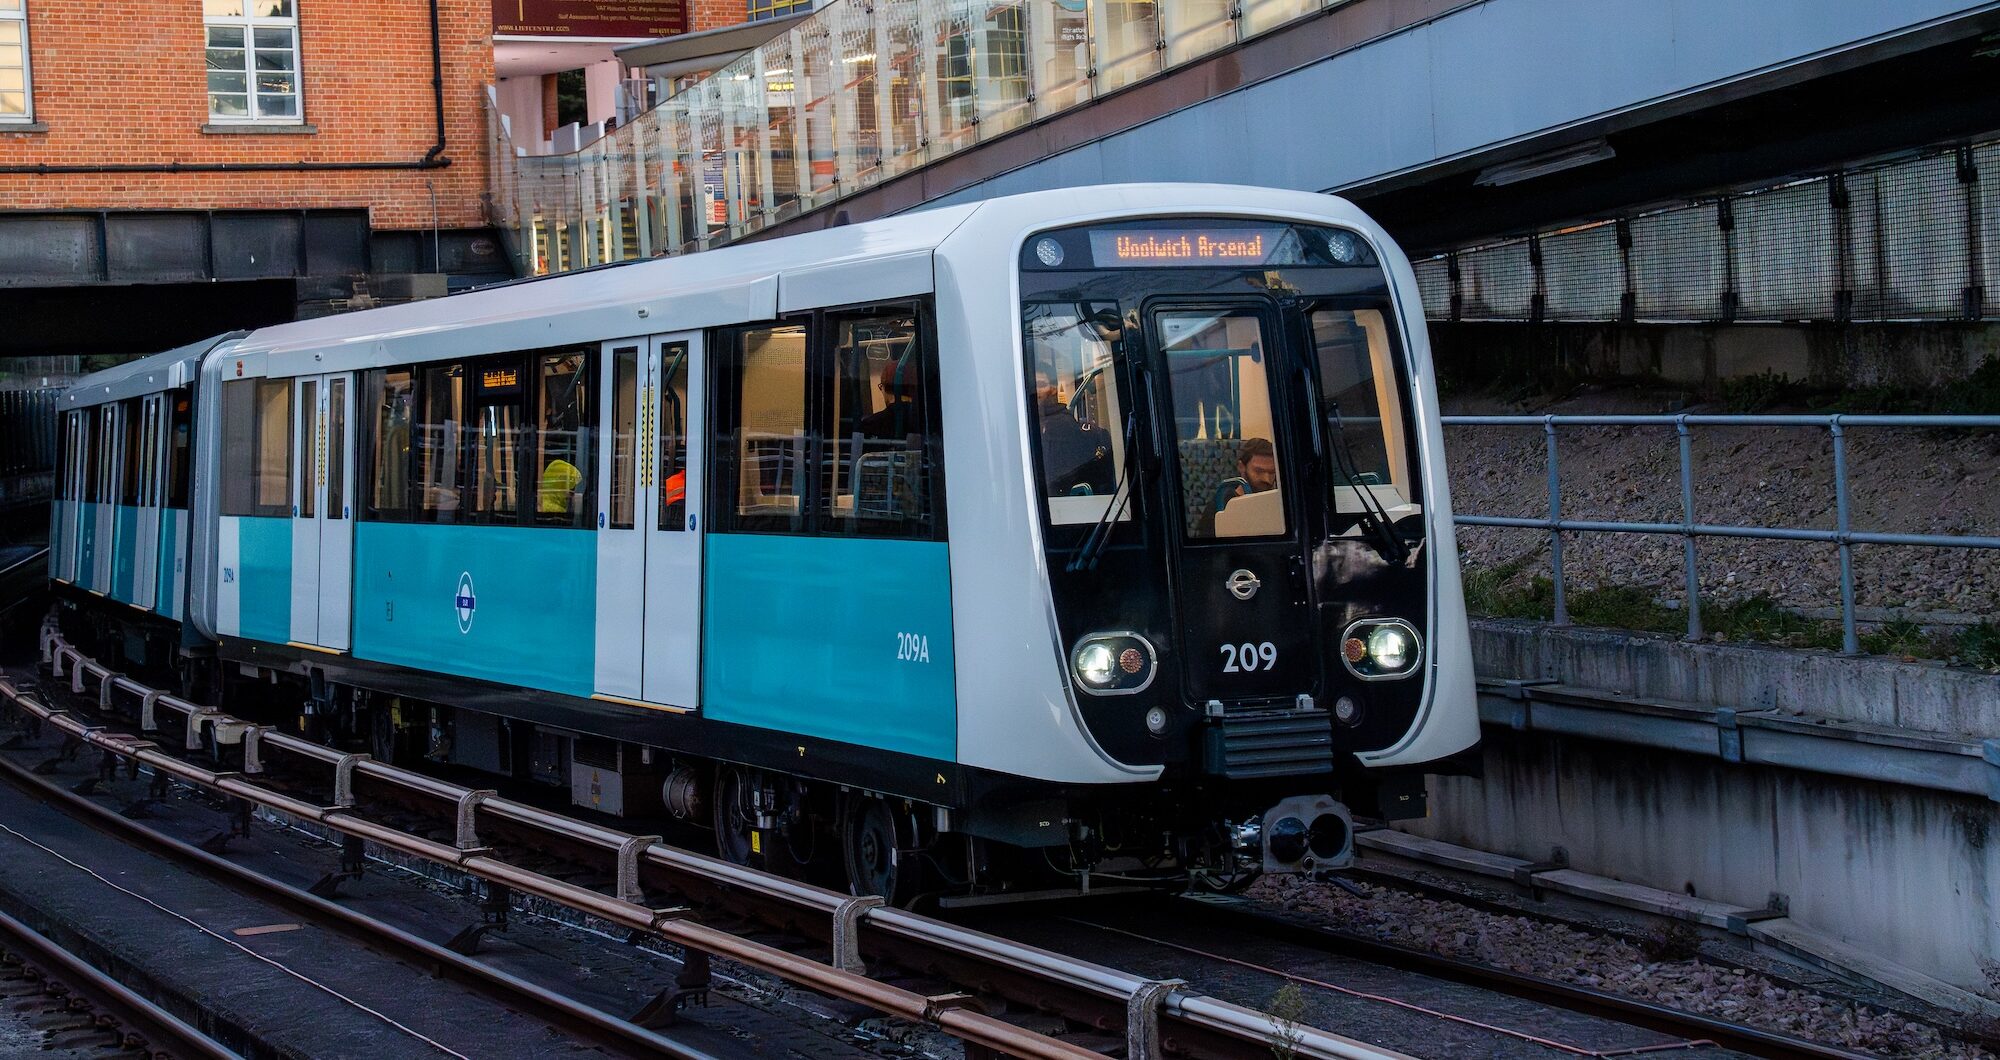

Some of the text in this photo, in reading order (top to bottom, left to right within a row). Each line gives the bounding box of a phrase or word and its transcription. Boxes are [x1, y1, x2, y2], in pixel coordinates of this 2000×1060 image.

[1117, 235, 1262, 258] Woolwich Arsenal
[897, 631, 930, 664] 209A
[1220, 641, 1278, 673] 209
